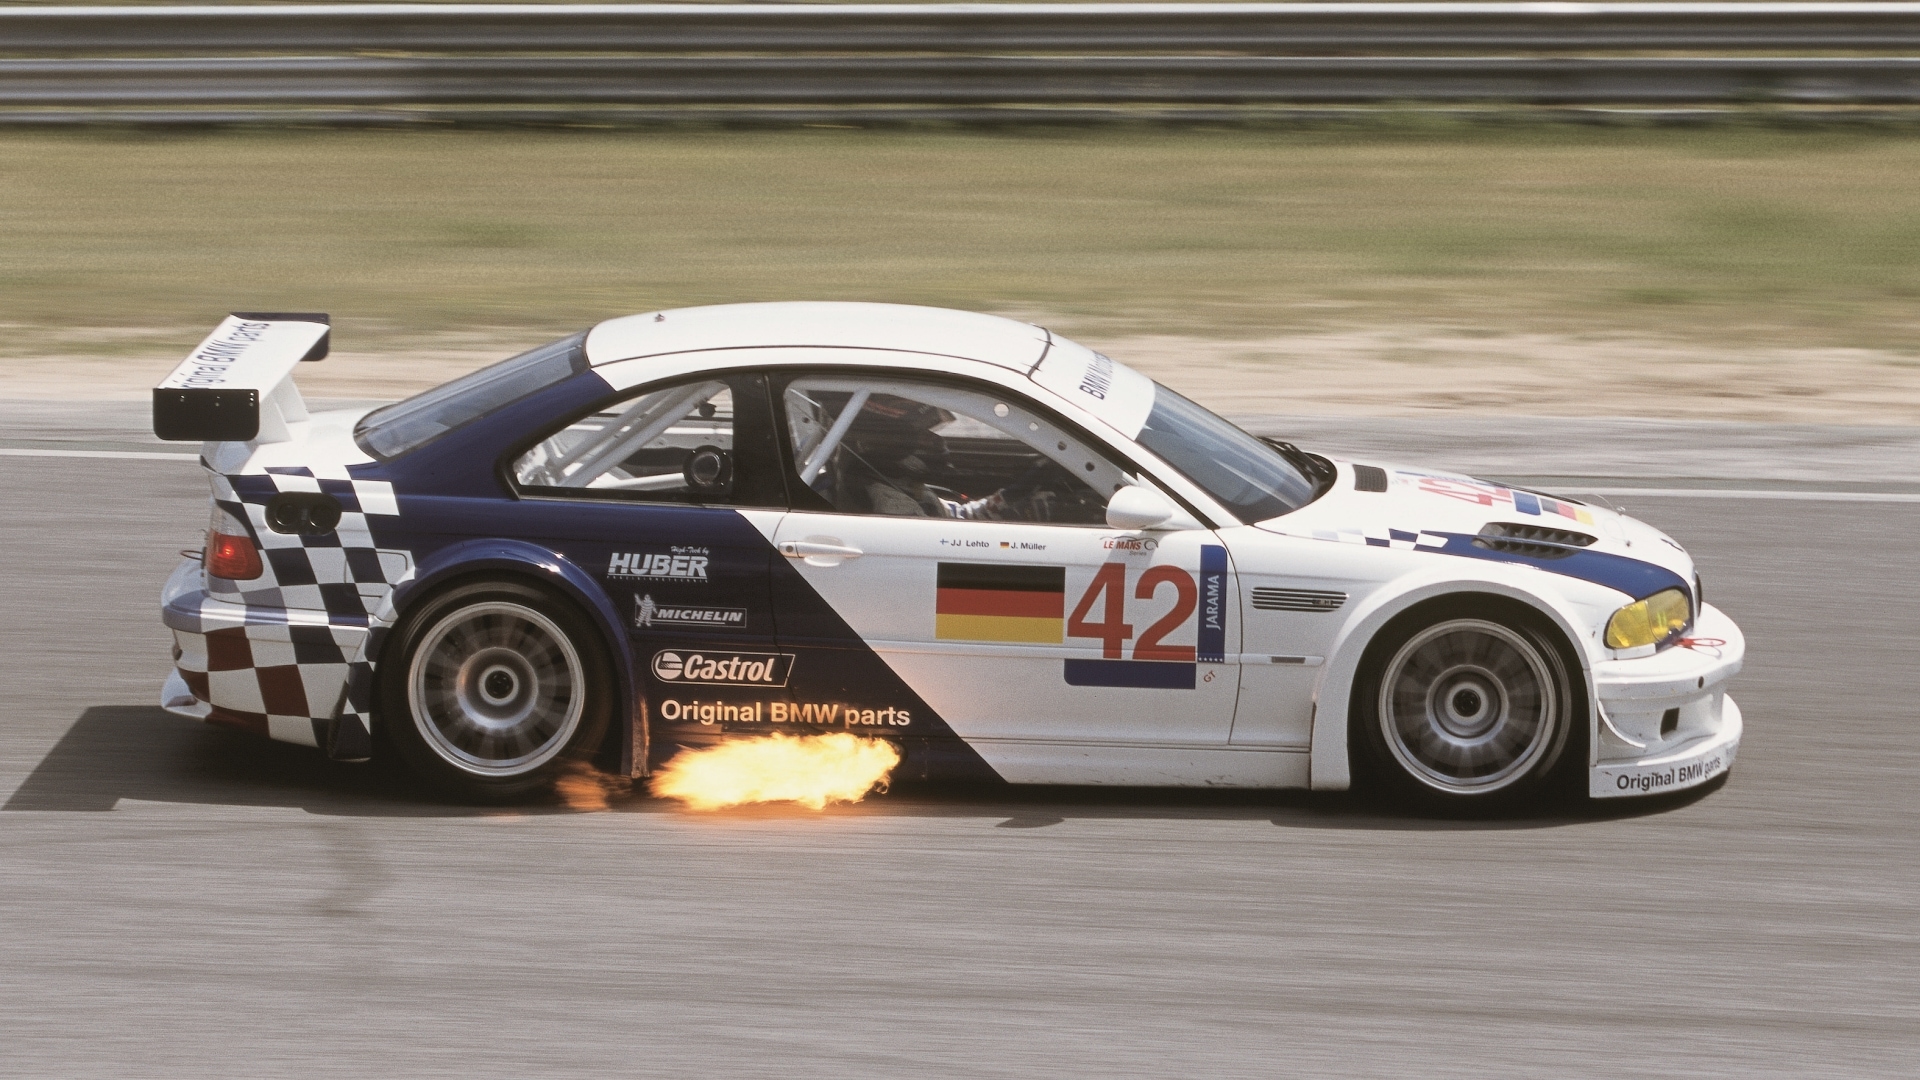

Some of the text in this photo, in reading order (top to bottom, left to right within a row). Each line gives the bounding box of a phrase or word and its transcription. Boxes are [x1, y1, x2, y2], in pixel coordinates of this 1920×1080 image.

[197, 339, 250, 362] BMW
[228, 323, 269, 341] parts
[1079, 370, 1111, 400] BMW
[966, 540, 989, 548] Lehto
[1021, 542, 1046, 550] Müller
[1103, 541, 1141, 550] LE MANS
[608, 552, 709, 577] HUBER
[657, 608, 743, 623] MICHELIN
[1067, 562, 1197, 661] 42
[1205, 575, 1220, 630] JARAMA
[684, 655, 775, 682] Castrol
[1203, 670, 1216, 683] GT
[661, 700, 911, 729] Original BMW parts
[1617, 757, 1721, 791] Original BMW parts
